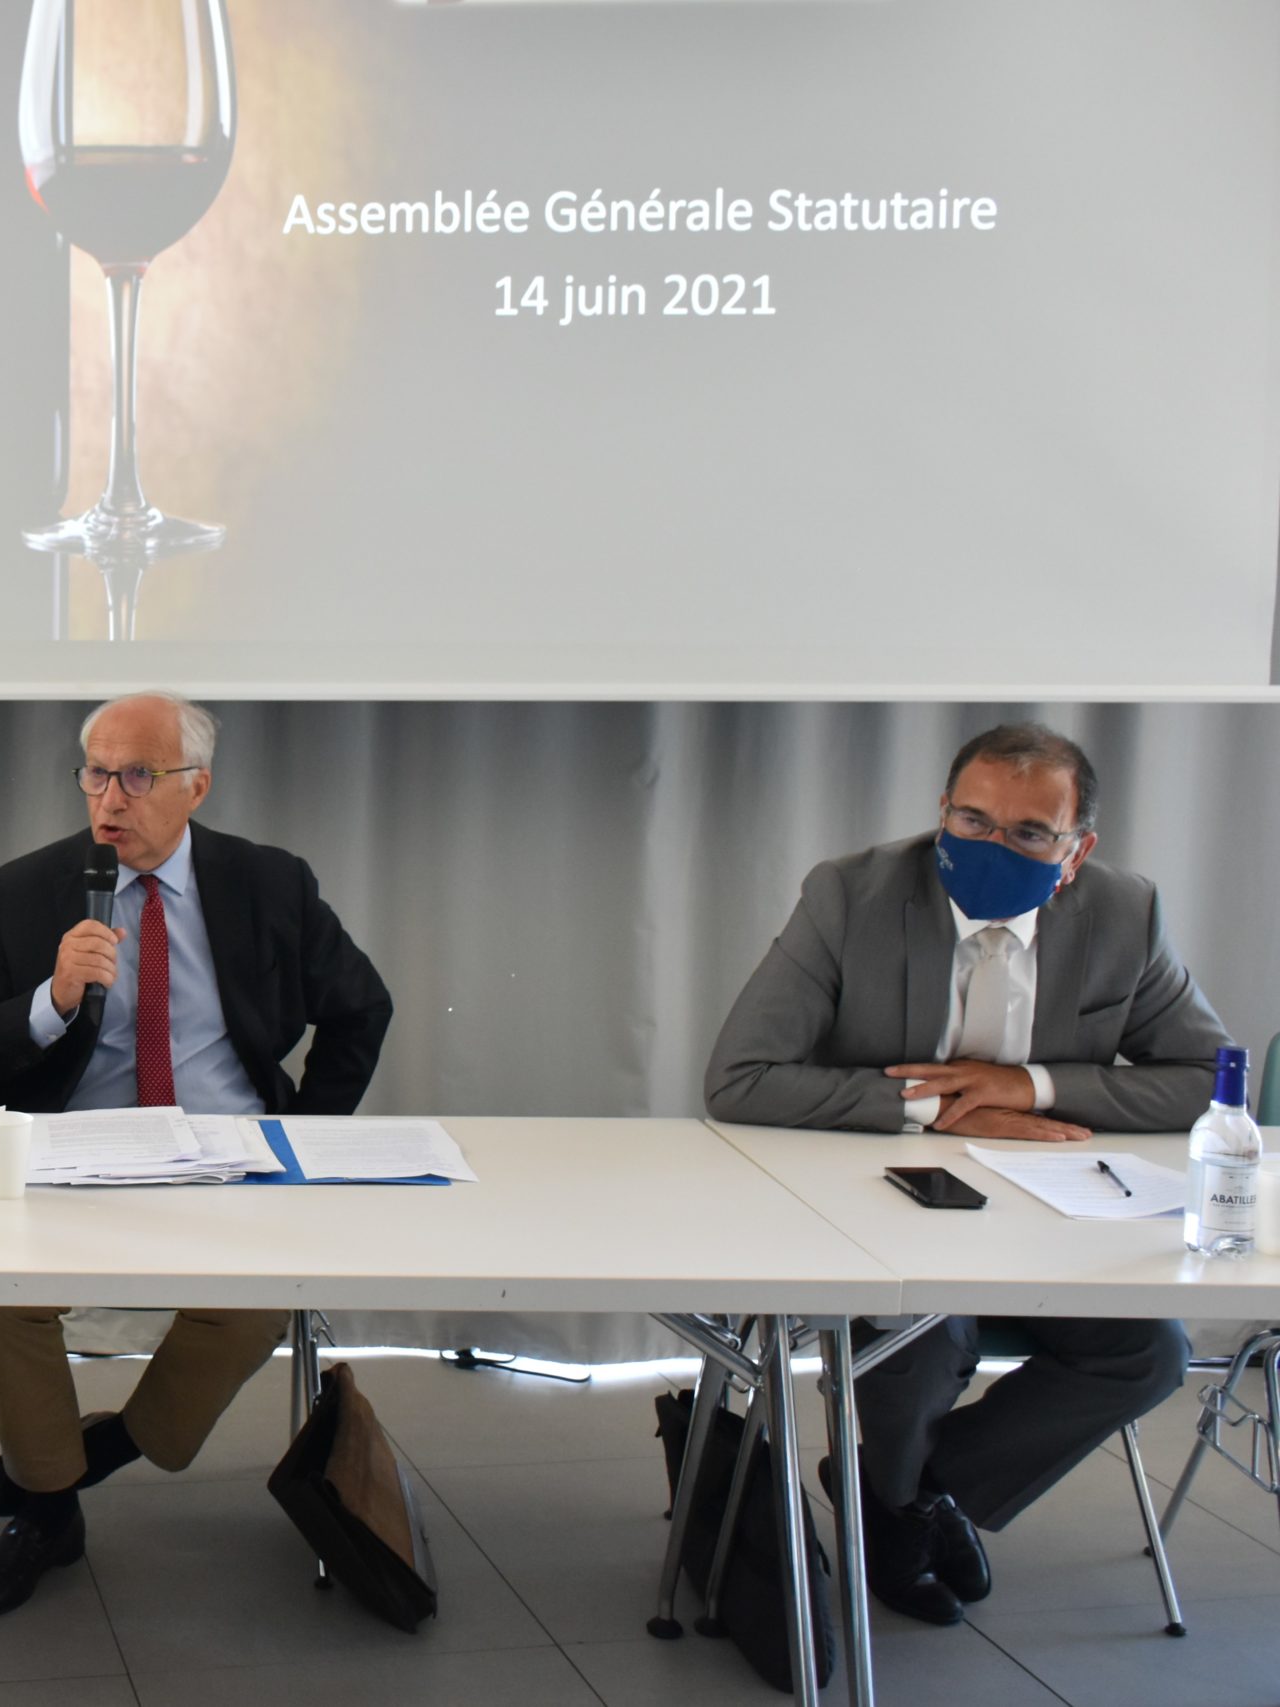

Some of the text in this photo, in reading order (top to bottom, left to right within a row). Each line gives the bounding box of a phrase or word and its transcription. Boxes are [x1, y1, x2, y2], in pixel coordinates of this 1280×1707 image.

[282, 187, 999, 236] Assemblée Générale Statutaire
[493, 273, 778, 326] 14 juin 2021
